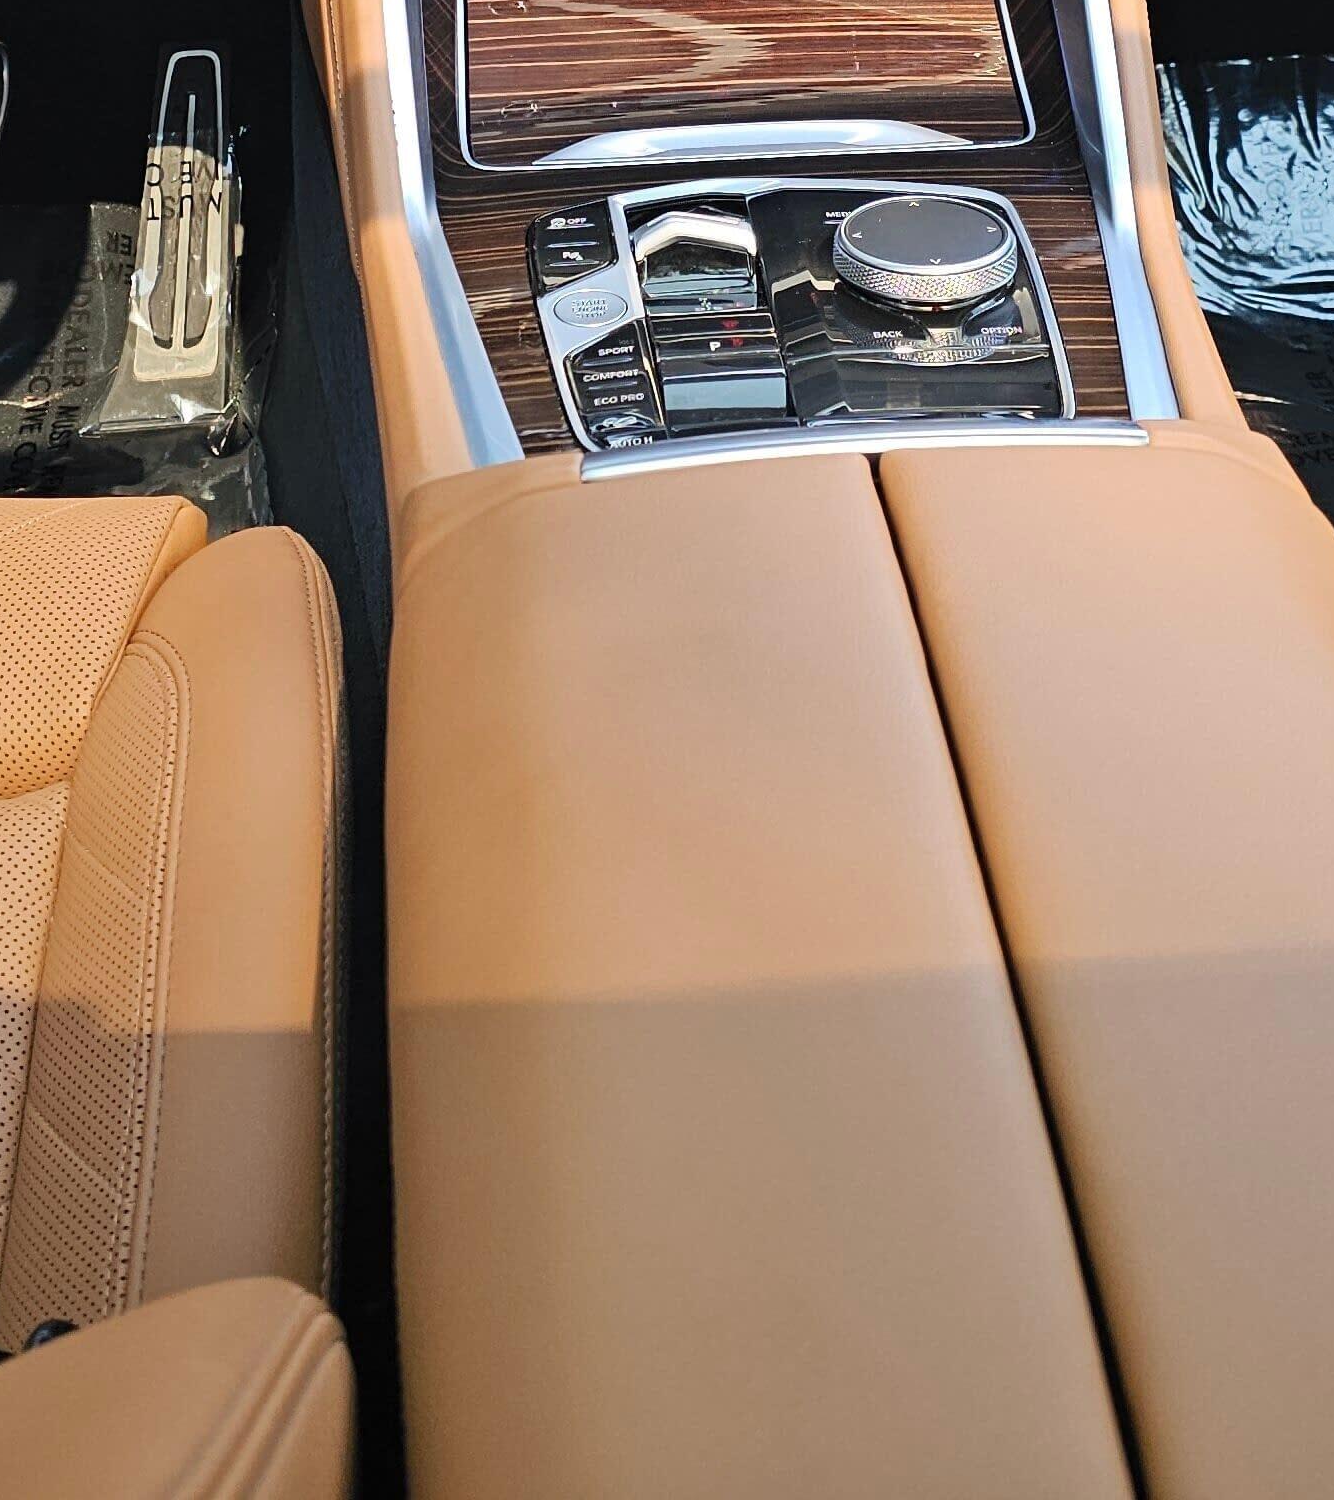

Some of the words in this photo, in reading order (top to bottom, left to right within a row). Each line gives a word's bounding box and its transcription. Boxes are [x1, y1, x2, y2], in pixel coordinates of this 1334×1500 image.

[873, 330, 904, 339] BACK
[980, 326, 1023, 335] OPTION
[598, 346, 635, 357] SPORT
[709, 342, 721, 352] P
[583, 369, 639, 383] COMFORT
[594, 397, 618, 407] ECO
[620, 393, 645, 404] PRO
